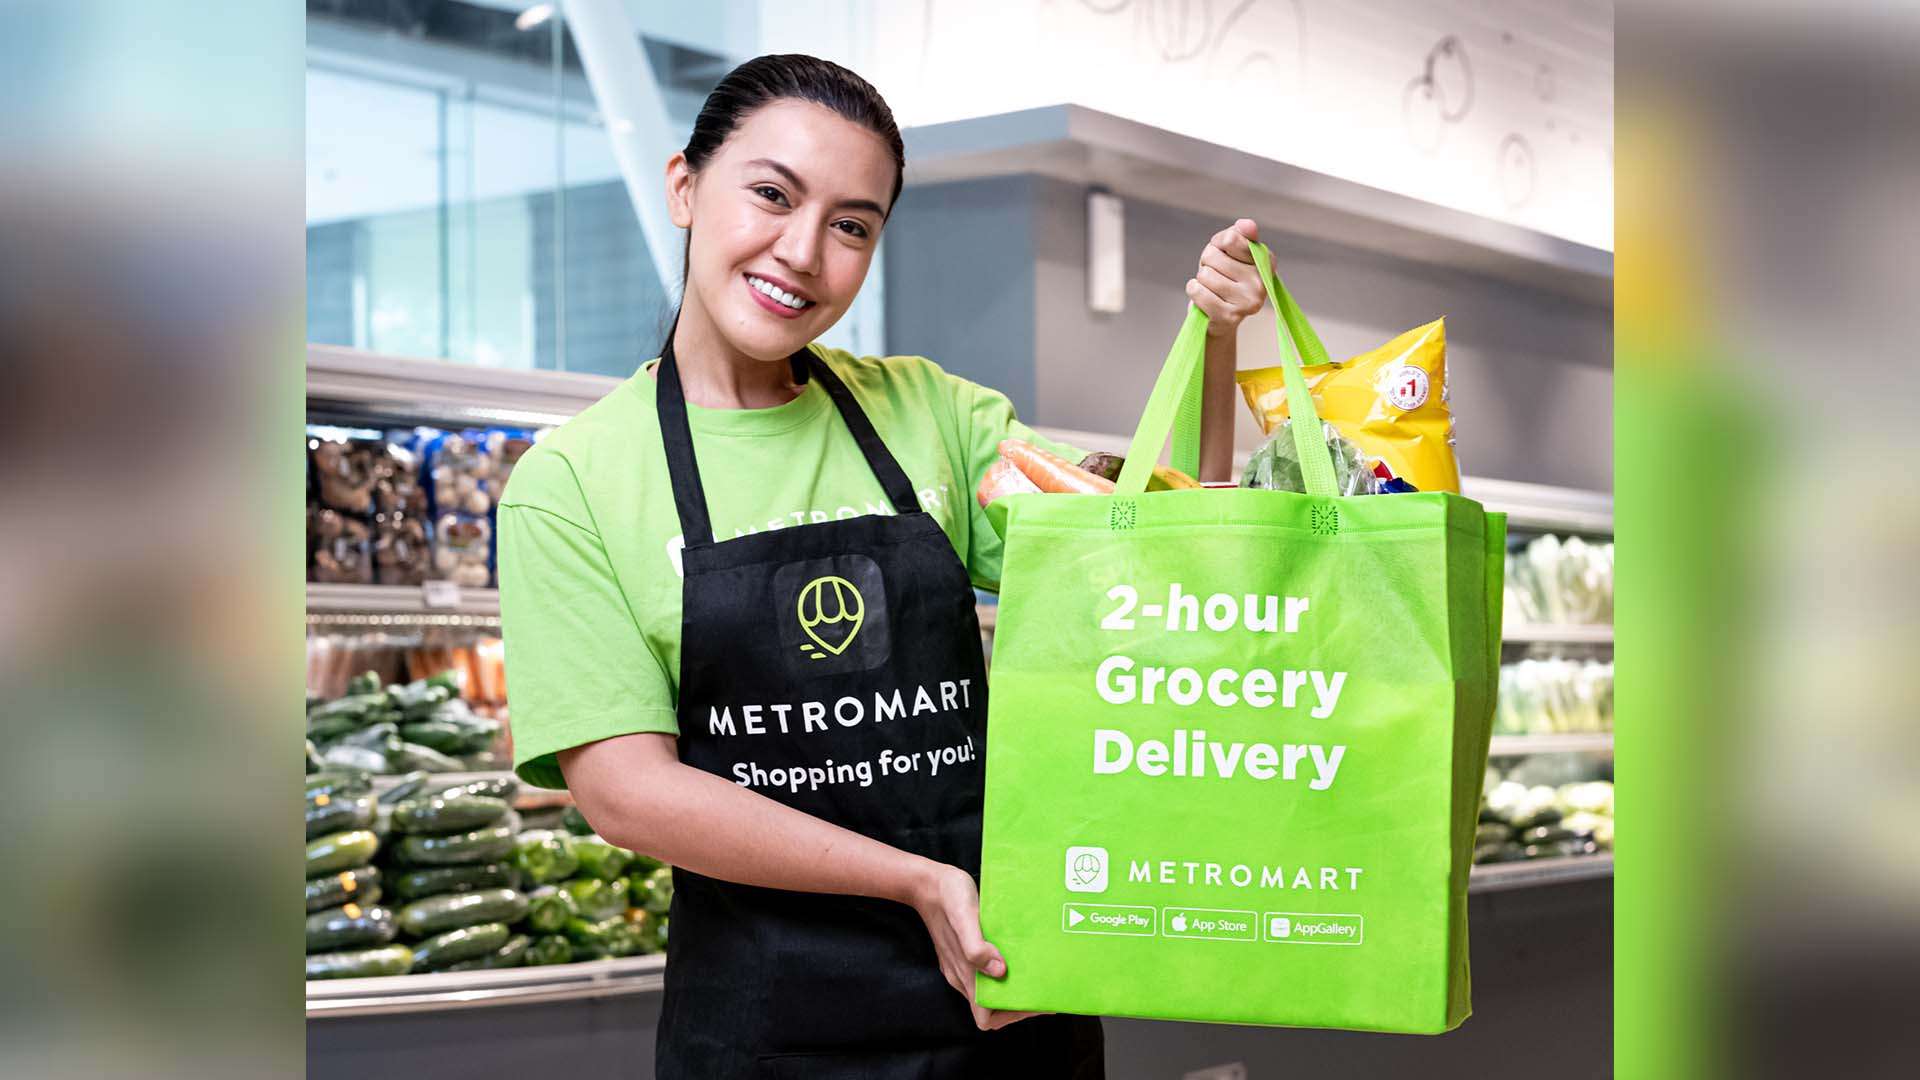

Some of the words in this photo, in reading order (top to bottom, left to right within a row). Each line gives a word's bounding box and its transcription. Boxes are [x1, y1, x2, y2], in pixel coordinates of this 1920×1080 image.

[734, 484, 949, 537] ETROMRT
[1100, 583, 1309, 633] 2-hour
[709, 679, 971, 736] METROMART
[1095, 655, 1348, 719] Grocery
[732, 759, 873, 793] Shopping
[878, 750, 921, 776] for
[926, 736, 976, 776] you!
[1093, 729, 1347, 791] Delivery
[1128, 860, 1363, 890] METROMART
[1090, 912, 1127, 927] Google
[1128, 914, 1150, 928] Play
[1192, 918, 1216, 932] App
[1218, 919, 1248, 932] Store
[1293, 922, 1357, 938] AppGallery
